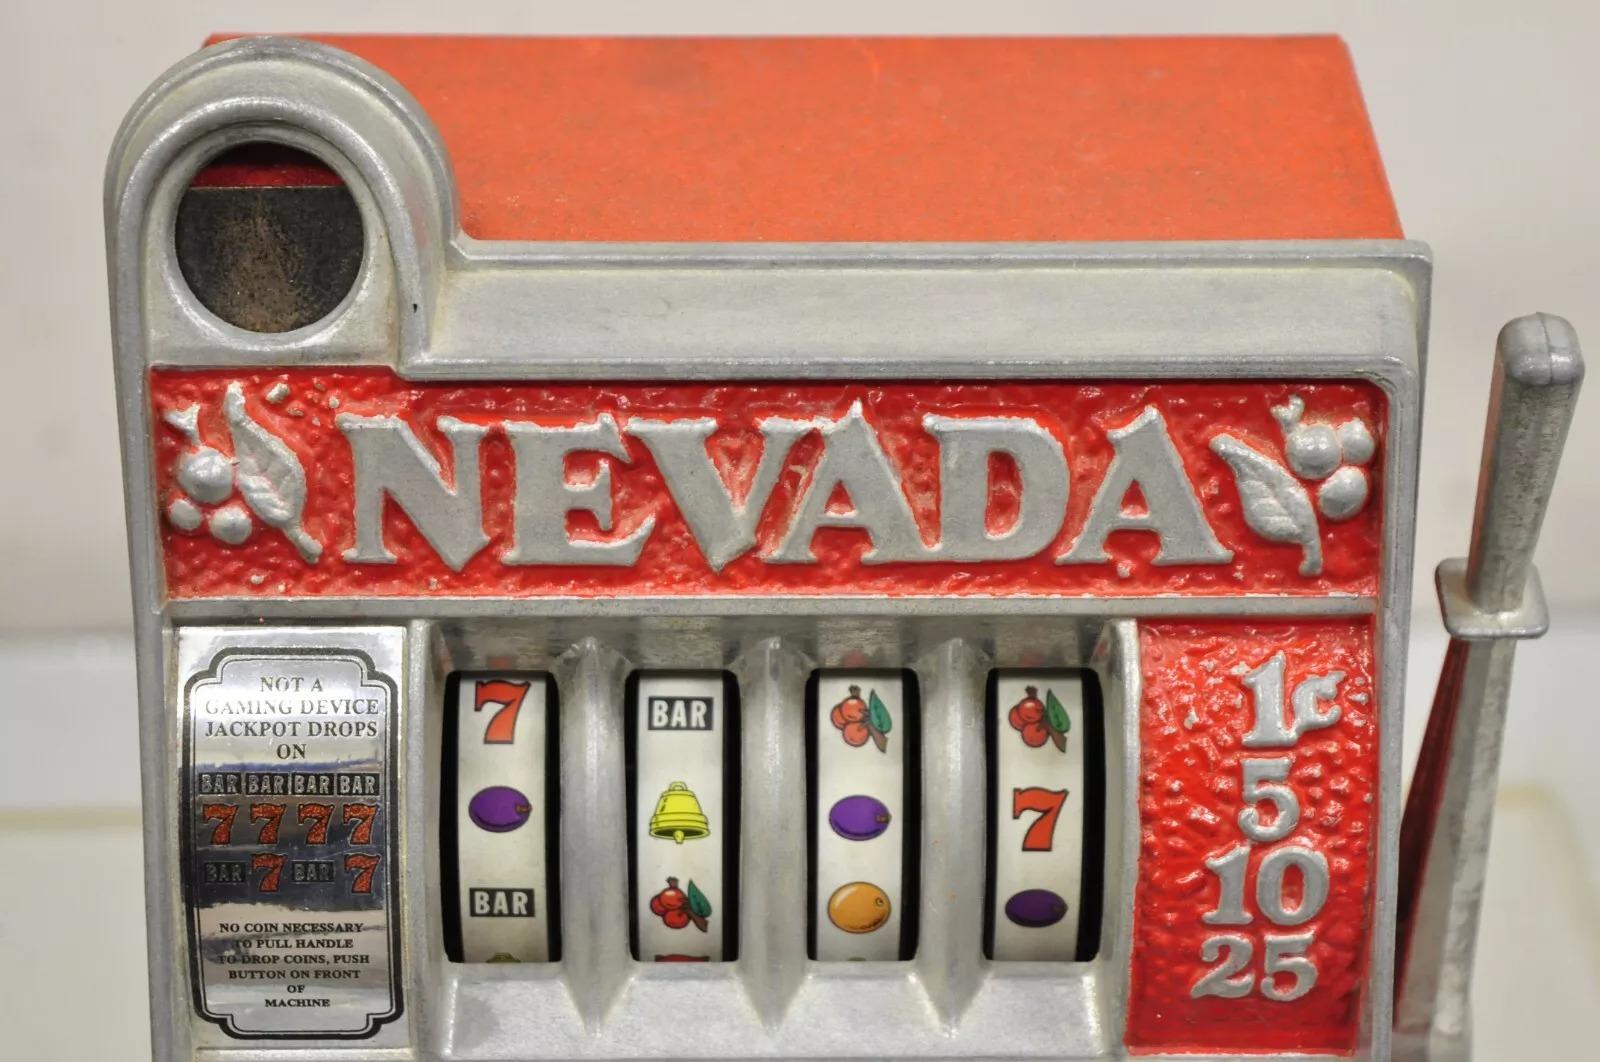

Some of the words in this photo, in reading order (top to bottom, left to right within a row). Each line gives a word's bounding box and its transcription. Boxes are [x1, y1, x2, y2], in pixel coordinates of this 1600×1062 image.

[338, 398, 1235, 572] NEVADA
[260, 676, 305, 692] NOT
[311, 679, 323, 692] A
[205, 699, 292, 715] GAMING
[300, 699, 379, 715] DEVICE
[474, 679, 532, 745] 7
[653, 700, 706, 729] BAR
[205, 721, 301, 737] JACKPOT
[307, 721, 377, 737] DROPS
[276, 743, 306, 760] ON
[201, 774, 239, 793] BAR
[248, 774, 285, 793] BAR
[294, 774, 330, 793] BAR
[340, 774, 375, 793] BAR
[1237, 756, 1299, 843] 5
[202, 802, 239, 845] 7
[250, 802, 287, 845] 7
[297, 802, 335, 845] 7
[343, 802, 379, 845] 7
[1012, 786, 1070, 852] 7
[206, 863, 243, 881] BAR
[252, 853, 287, 893] 7
[294, 863, 329, 881] BAR
[344, 853, 381, 894] 7
[1203, 843, 1330, 926] 10
[474, 893, 528, 916] BAR
[219, 923, 240, 933] NO
[244, 923, 279, 933] COIN
[283, 923, 364, 933] NECESSARY
[235, 939, 252, 949] TO
[256, 939, 292, 949] PULL
[296, 939, 354, 949] HANDLE
[218, 954, 237, 964] TO
[242, 954, 280, 964] DROP
[284, 954, 330, 966] COINS,
[334, 954, 369, 964] PUSH
[1189, 931, 1319, 1002] 25
[228, 970, 286, 980] BUTTON
[290, 970, 310, 980] ON
[314, 970, 361, 980] FRONT
[287, 984, 306, 994] OF
[264, 998, 331, 1008] MACHINE
